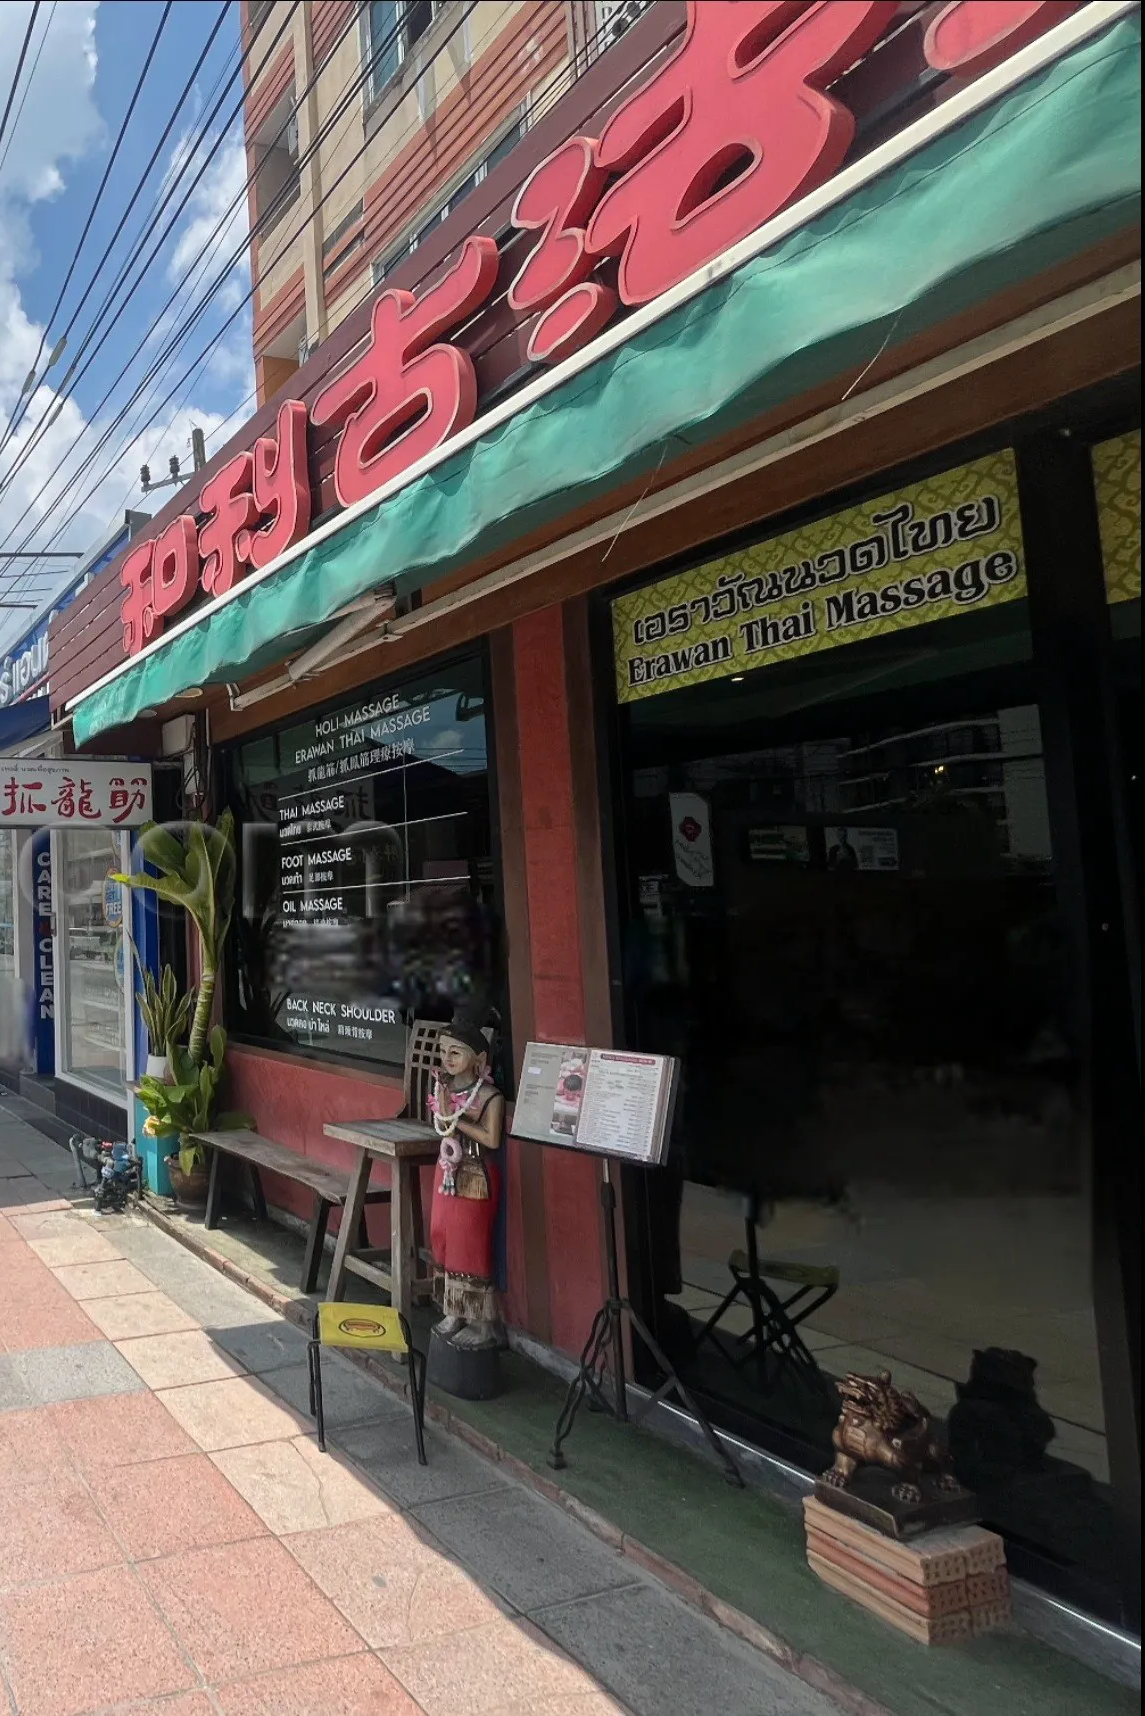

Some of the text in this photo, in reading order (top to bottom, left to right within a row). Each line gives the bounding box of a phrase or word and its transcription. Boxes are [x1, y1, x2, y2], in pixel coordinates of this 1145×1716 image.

[632, 496, 1002, 646] เอราวัณนวดไทย
[627, 550, 1018, 688] Erawan Thai Massage
[295, 705, 431, 765] ERAWAN THAI MASSAGE
[315, 693, 400, 738] HOLI MASSAGE
[1, 776, 148, 824] 抓龍筋
[279, 795, 345, 821] THAI MASSAGE
[281, 847, 352, 869] FOOT MASSAGE
[37, 851, 52, 917] CARE
[282, 897, 343, 913] OIL MASSAGE
[38, 938, 56, 1020] CLEAN
[286, 997, 396, 1025] BACK NECK SHOULDER
